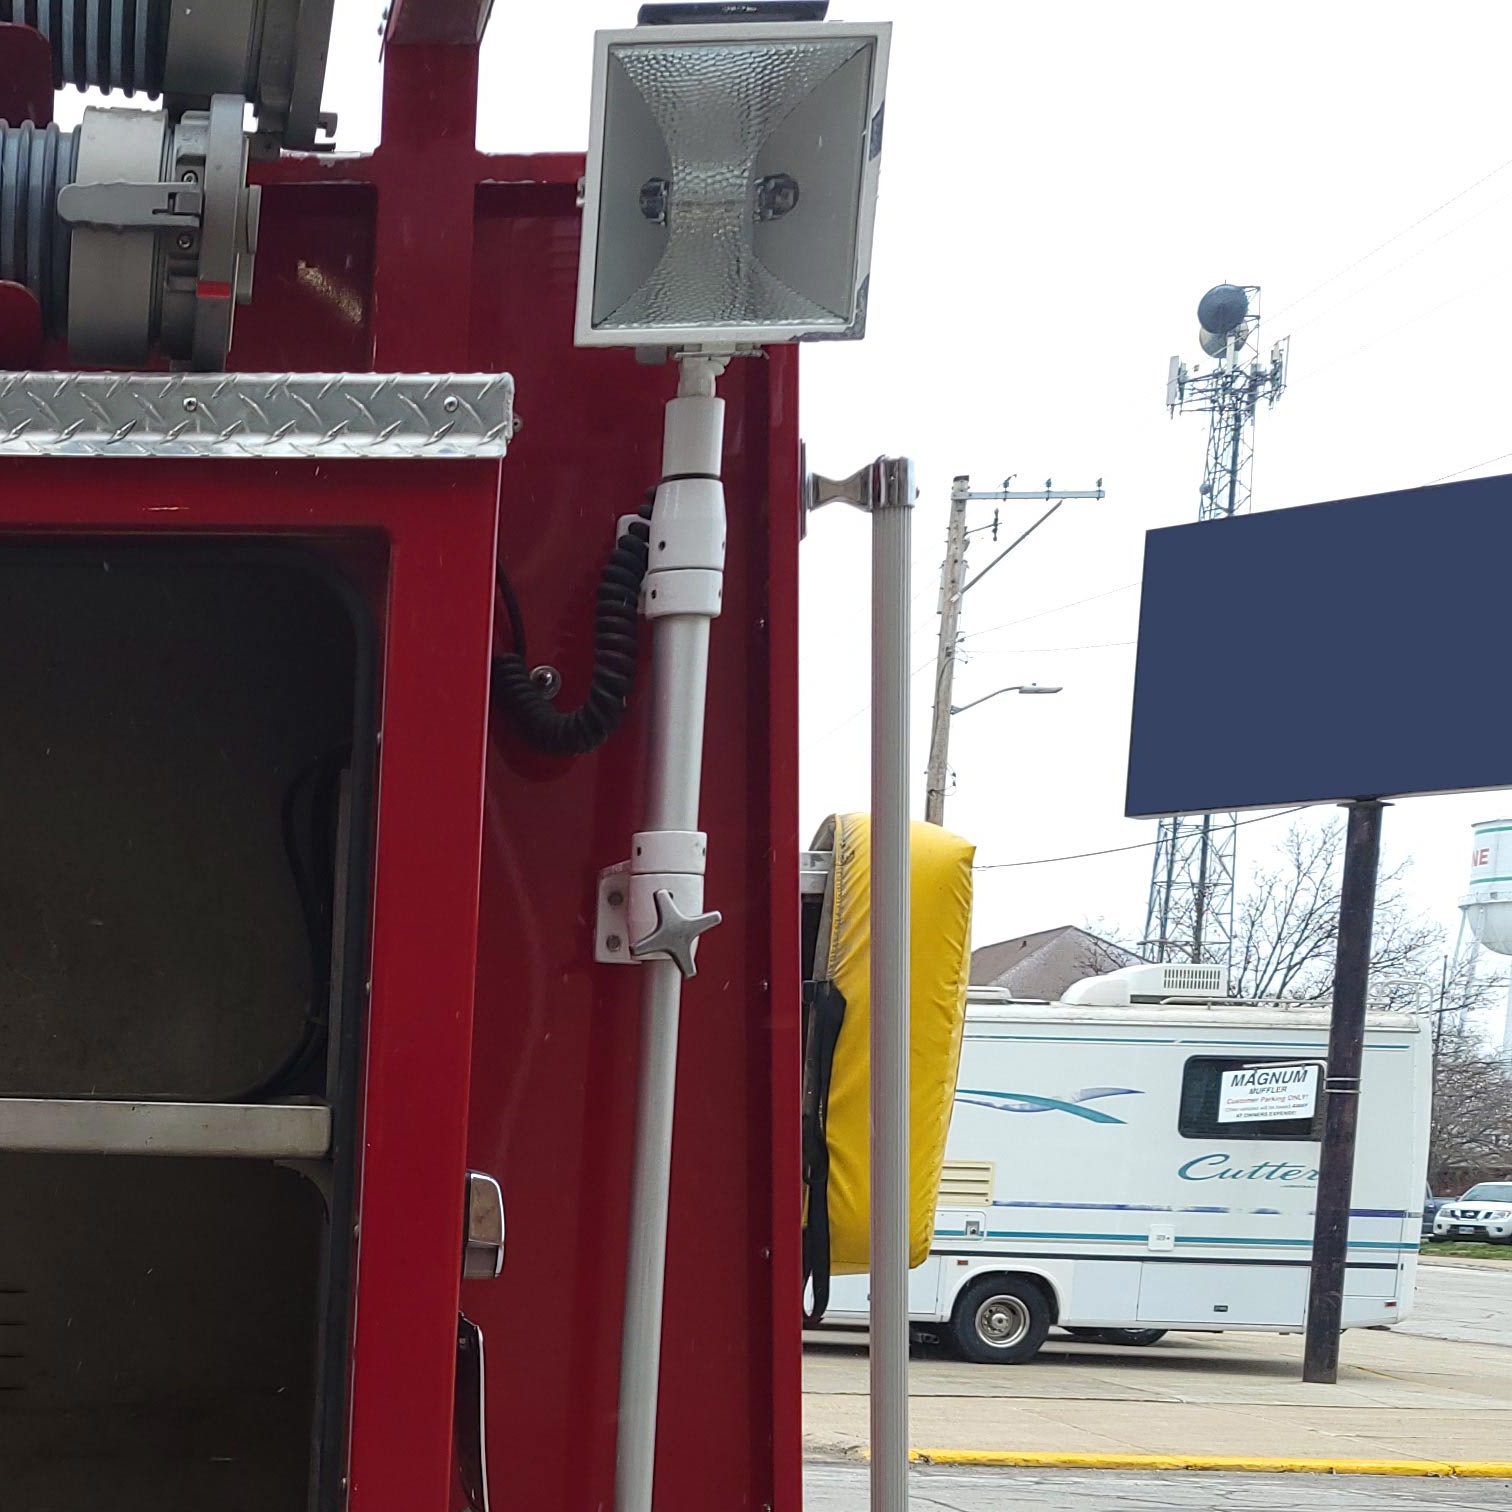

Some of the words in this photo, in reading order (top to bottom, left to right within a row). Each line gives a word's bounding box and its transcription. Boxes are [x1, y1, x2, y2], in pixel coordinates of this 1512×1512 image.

[1230, 1069, 1308, 1087] MAGNUM
[1249, 1086, 1288, 1095] MUFFLER
[1178, 1154, 1319, 1181] Cutter
